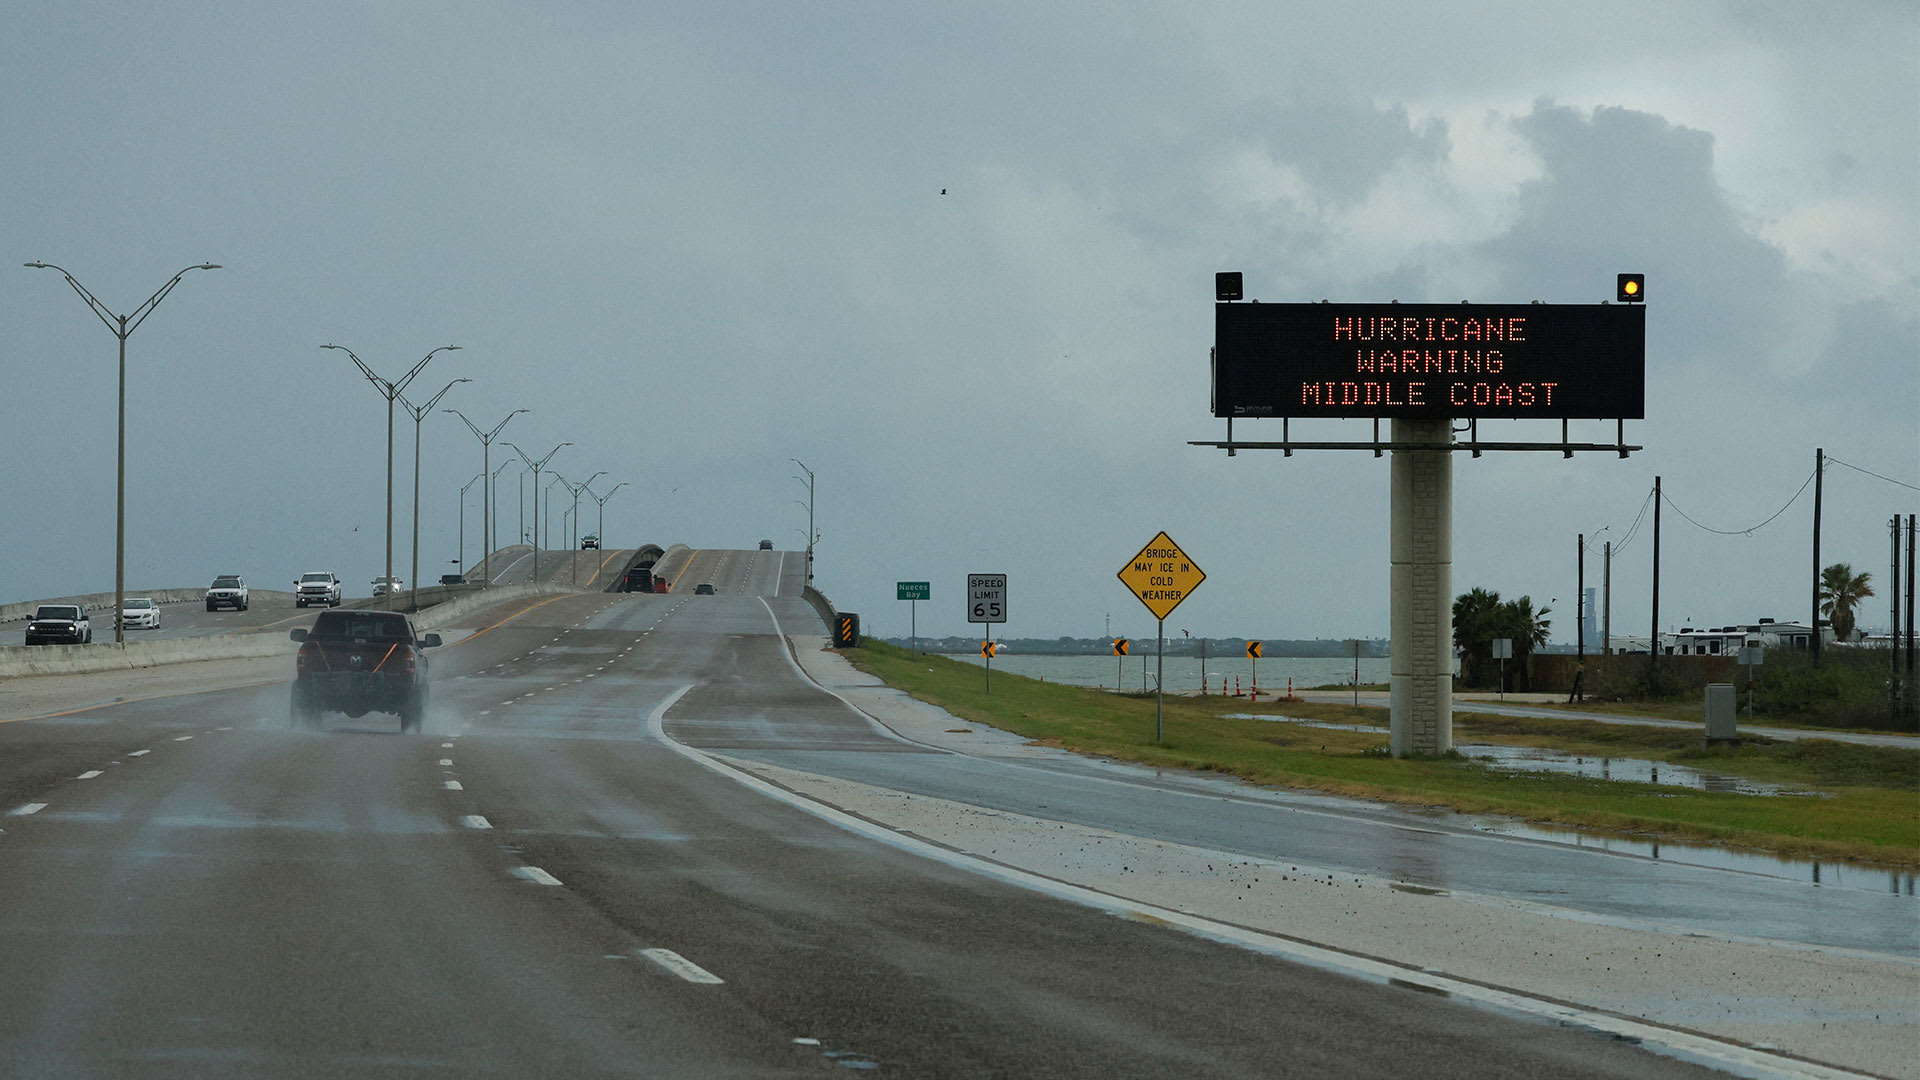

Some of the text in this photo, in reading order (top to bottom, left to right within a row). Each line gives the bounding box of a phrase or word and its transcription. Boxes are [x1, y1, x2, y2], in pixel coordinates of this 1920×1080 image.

[1335, 317, 1526, 341] HURRICANE
[1357, 349, 1503, 373] WARNING
[1302, 381, 1558, 406] MIDDLE COAST
[1146, 548, 1178, 559] BRIDGE
[1134, 562, 1190, 573] MAY ICE IN
[971, 579, 1004, 588] SPEED
[1150, 576, 1173, 586] COLD
[906, 591, 921, 599] Bay
[974, 591, 1000, 599] LIMIT
[1141, 590, 1182, 600] WEATHER
[973, 602, 1001, 617] 65
